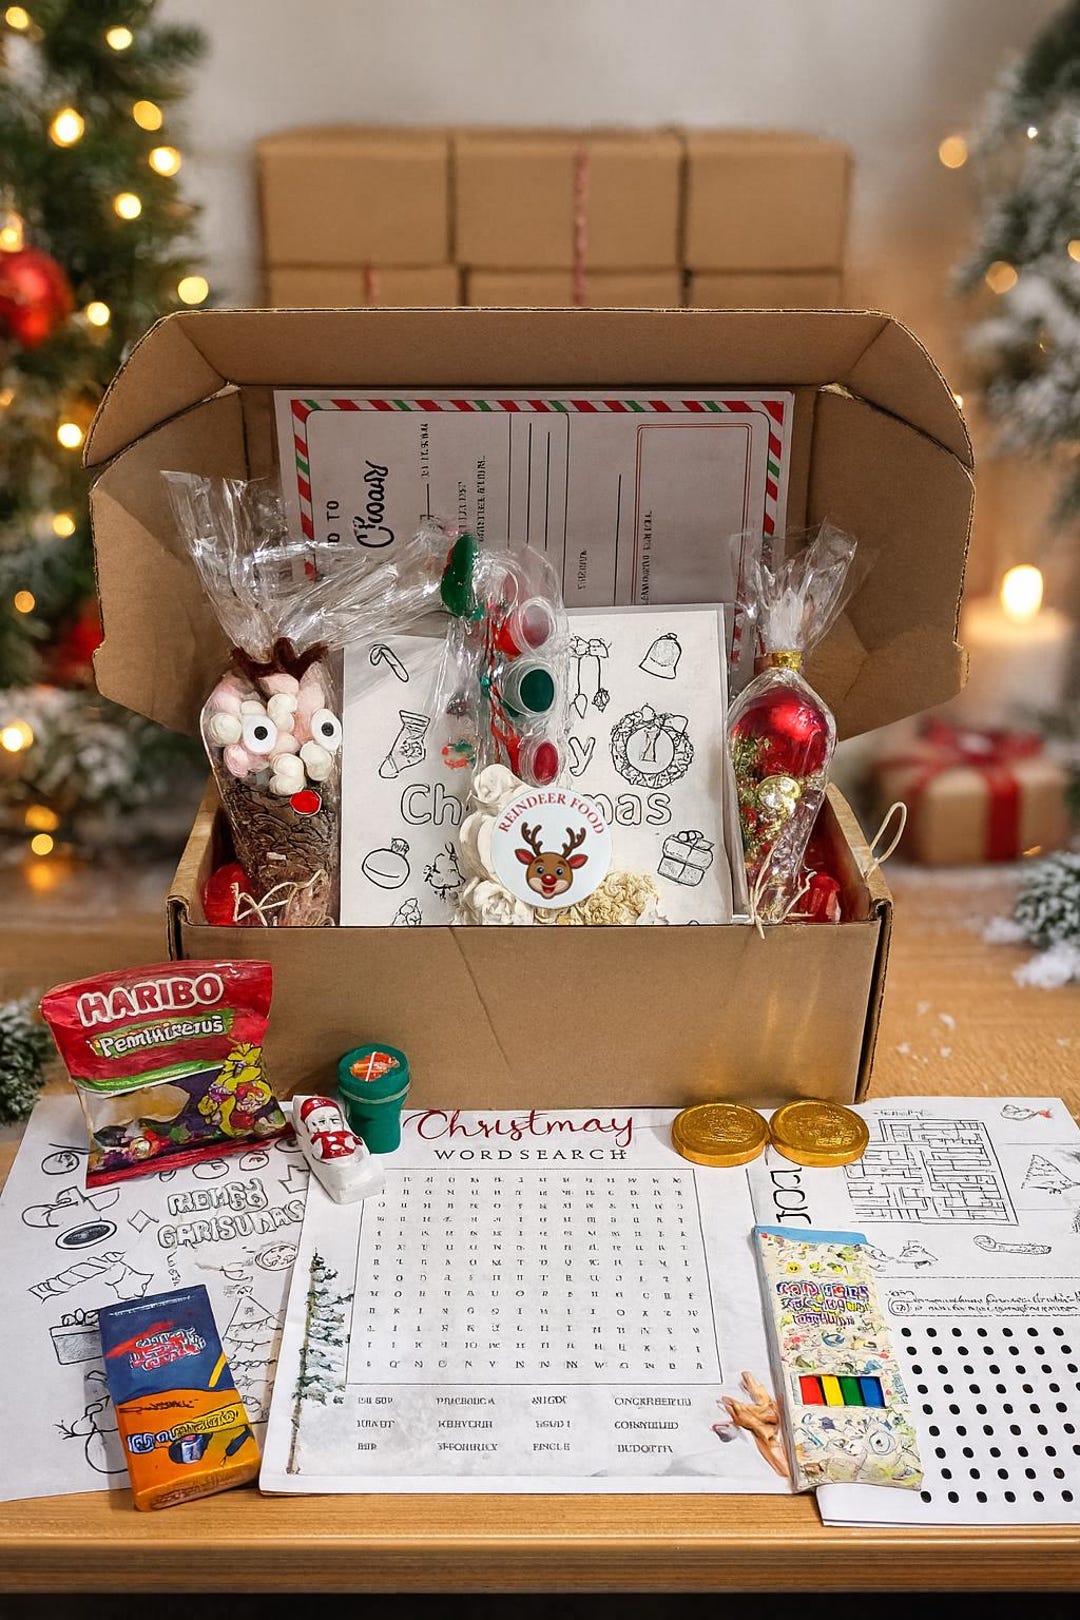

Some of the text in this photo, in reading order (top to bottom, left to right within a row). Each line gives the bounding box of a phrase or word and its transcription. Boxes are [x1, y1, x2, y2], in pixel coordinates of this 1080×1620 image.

[498, 793, 604, 834] REINDEER FOOD
[77, 972, 224, 1028] HARIBO
[434, 1149, 628, 1160] WORDSEARCH
